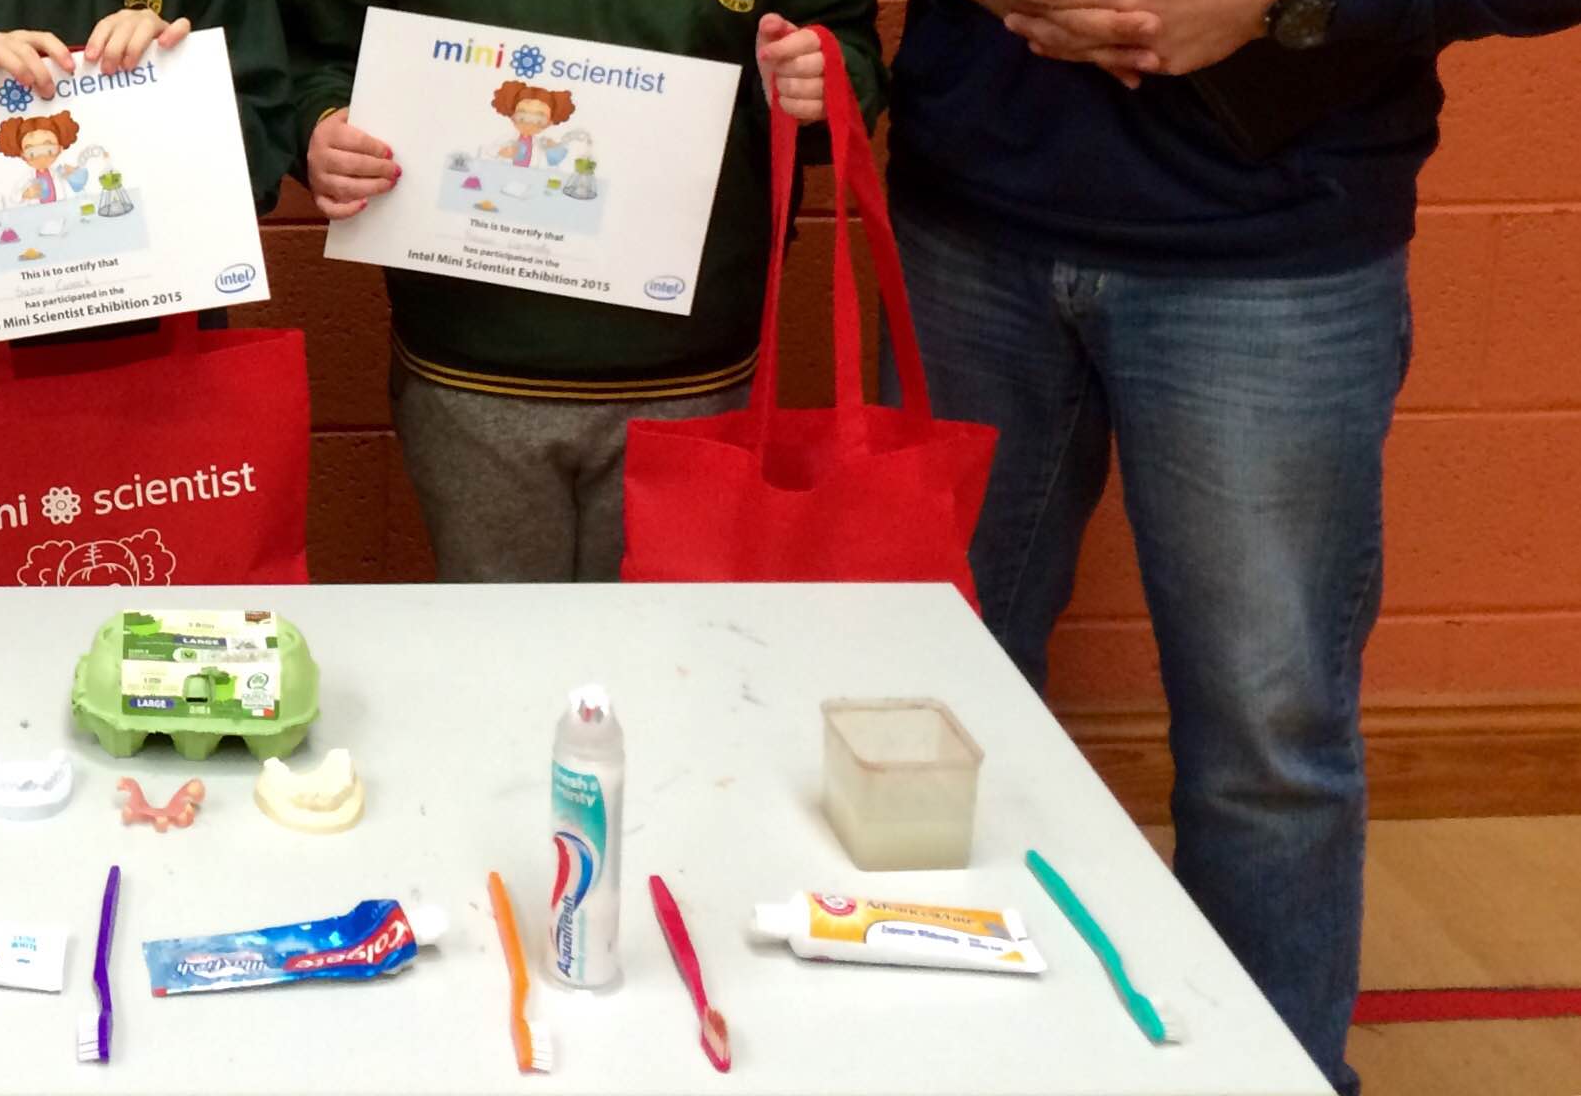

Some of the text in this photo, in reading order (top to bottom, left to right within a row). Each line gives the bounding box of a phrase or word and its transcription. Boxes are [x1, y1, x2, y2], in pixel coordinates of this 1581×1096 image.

[432, 38, 665, 94] mini scientist
[470, 219, 488, 229] This
[490, 222, 498, 230] is
[500, 223, 510, 233] to
[21, 257, 119, 281] This is to certify that
[220, 269, 251, 287] intel
[408, 249, 611, 292] Intel Mini Scientist Exhibition 2015
[25, 286, 124, 309] has participated in the
[649, 278, 679, 294] intel
[3, 313, 30, 329] Mini
[33, 306, 84, 325] Scientist
[87, 296, 150, 316] Exhibition
[152, 291, 182, 306] 2015
[94, 462, 256, 515] scientist
[182, 637, 220, 646] LARGE
[137, 699, 168, 709] LARGE
[294, 919, 409, 970] Colgate
[557, 896, 575, 978] Aquafresh
